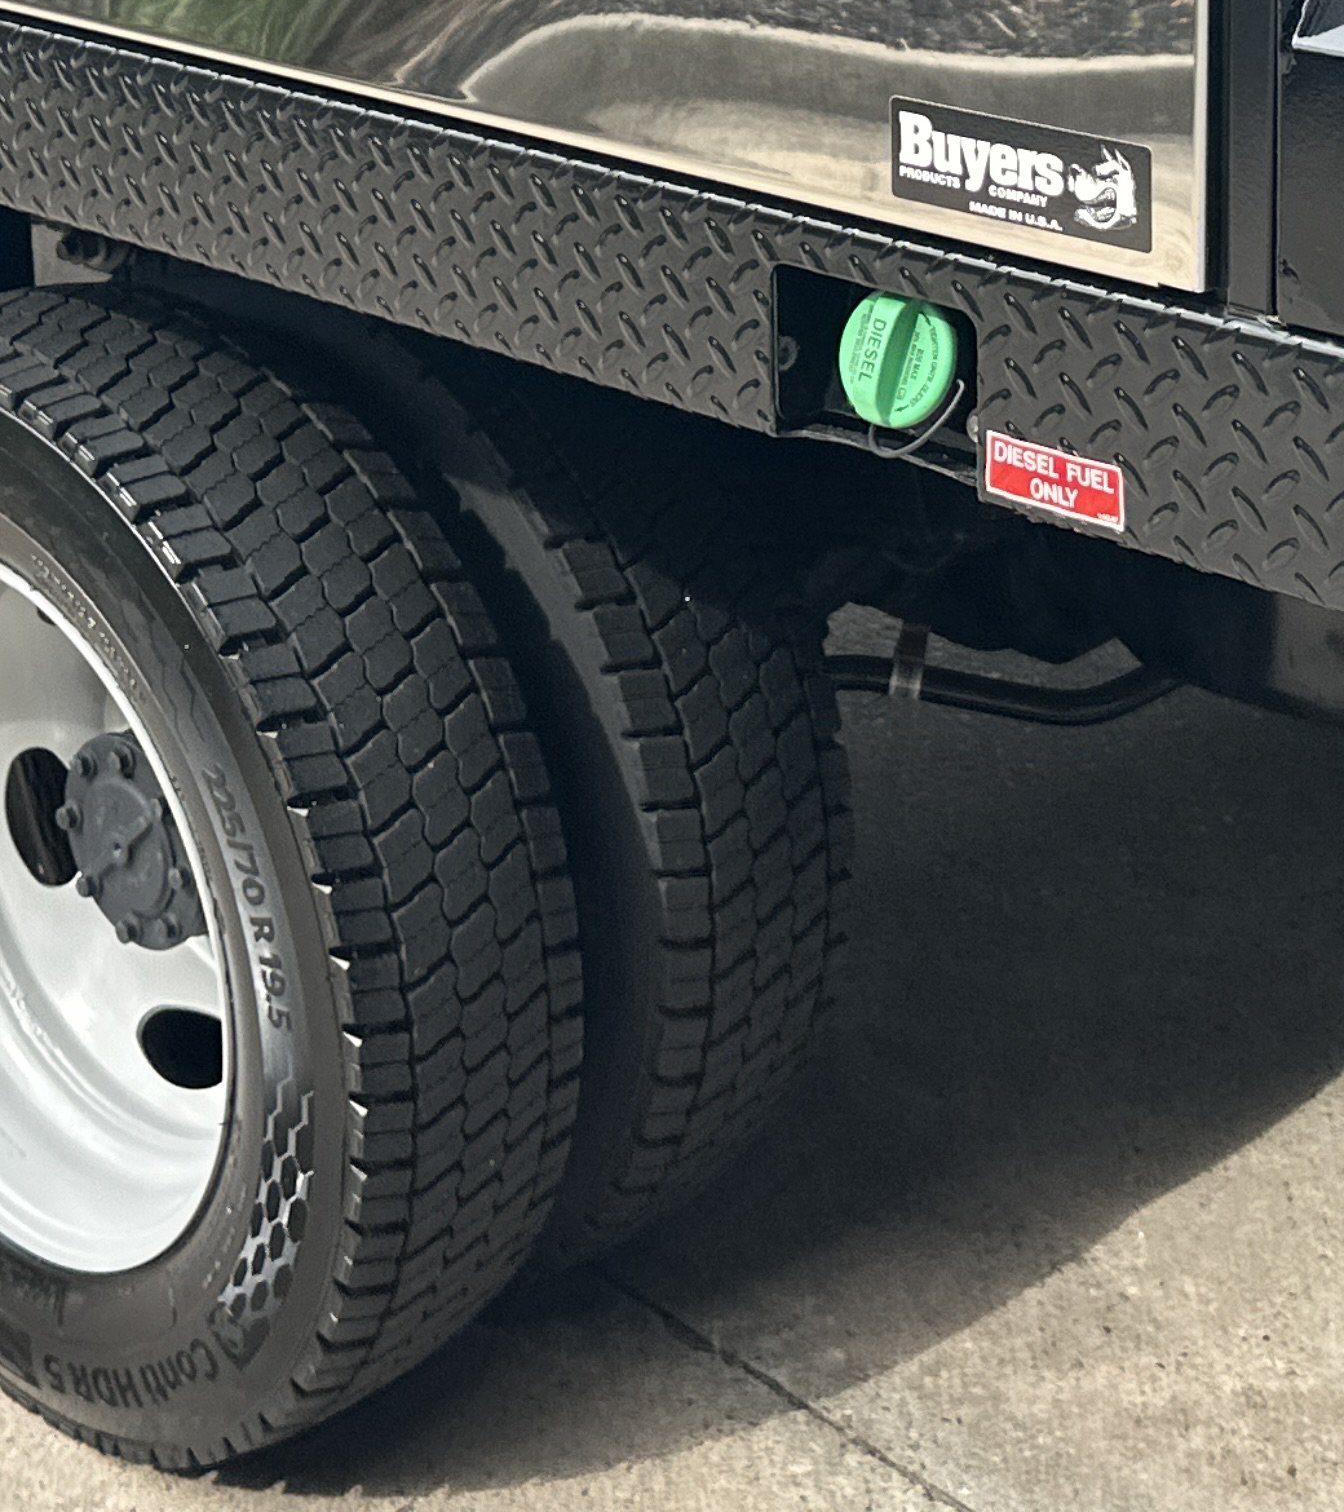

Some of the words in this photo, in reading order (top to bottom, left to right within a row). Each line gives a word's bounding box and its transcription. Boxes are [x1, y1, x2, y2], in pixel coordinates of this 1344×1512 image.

[898, 110, 1064, 196] Buyers
[899, 165, 960, 189] PRODUCTS
[988, 185, 1048, 208] COMPANY
[969, 201, 1006, 219] MADE
[1008, 209, 1023, 223] IN
[858, 318, 887, 382] DIESEL
[994, 441, 1060, 479] DIESEL
[1066, 463, 1115, 495] FUEL
[1029, 477, 1079, 508] ONLY
[202, 763, 266, 907] 225/70
